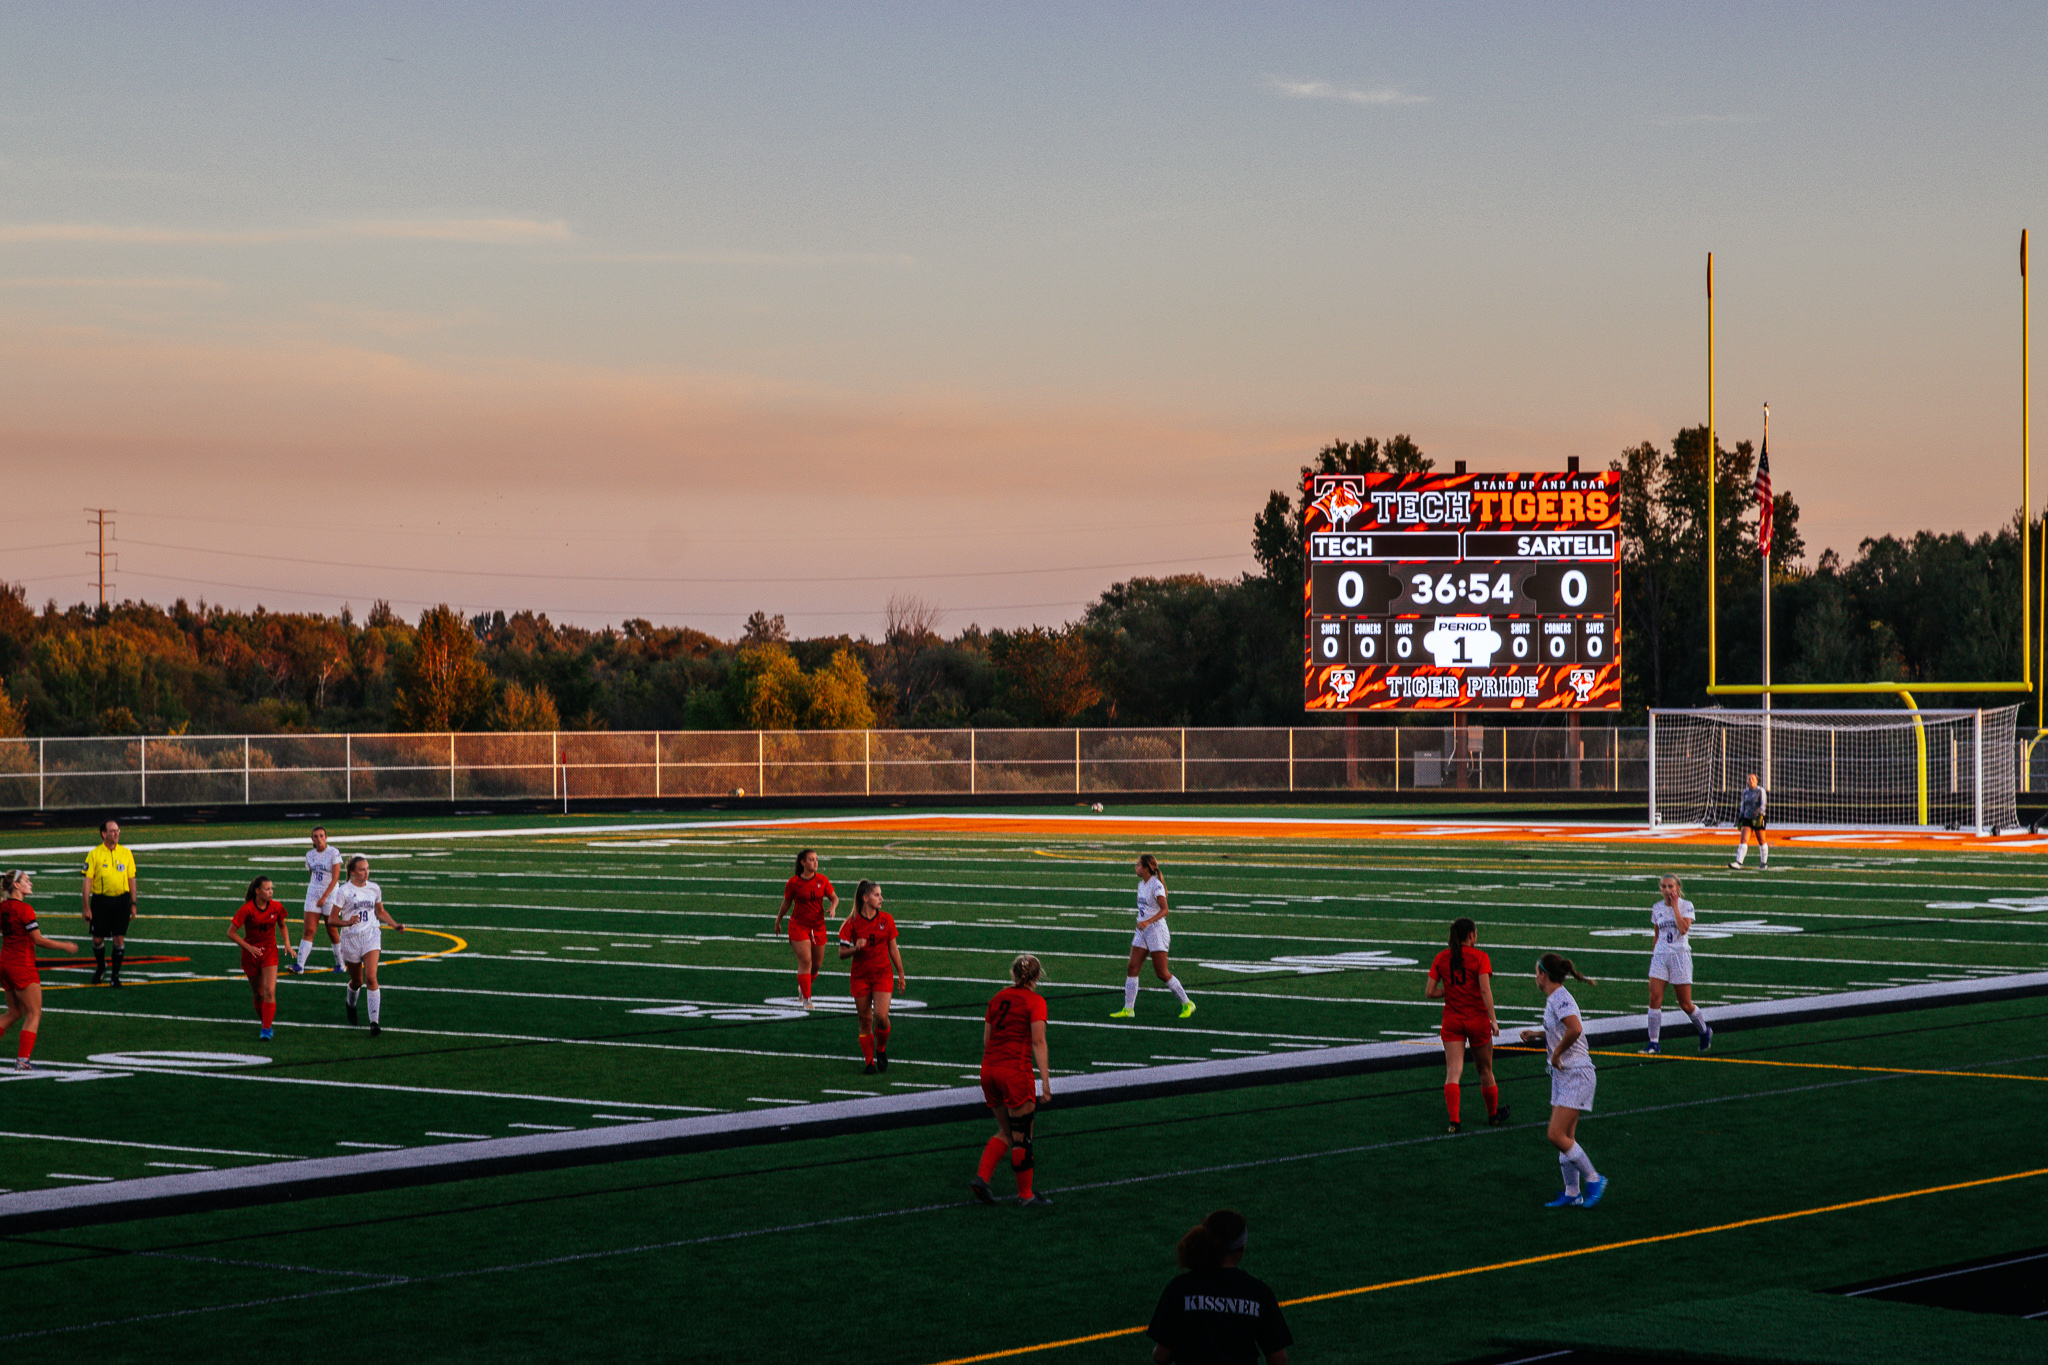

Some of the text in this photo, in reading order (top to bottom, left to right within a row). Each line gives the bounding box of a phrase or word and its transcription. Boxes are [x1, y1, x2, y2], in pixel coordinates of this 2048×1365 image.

[1473, 480, 1605, 490] STAND UP AND ROAR
[1371, 491, 1609, 523] TECH TIGERS
[1314, 537, 1373, 556] TECH
[1517, 536, 1612, 556] SARTELL
[1337, 571, 1365, 607] 0
[1411, 573, 1514, 604] 36:54
[1560, 569, 1588, 607] 0
[1321, 623, 1340, 635] SHOTS
[1354, 623, 1382, 635] CORNERS
[1394, 623, 1413, 635] SAVES
[1438, 622, 1487, 632] PERIOD
[1510, 623, 1530, 634] SHOTS
[1544, 622, 1572, 634] CORNERS
[1585, 622, 1604, 634] SAVES
[1323, 636, 1338, 658] 0
[1360, 636, 1375, 658] 0
[1397, 636, 1412, 658] 0
[1452, 637, 1472, 663] 1
[1512, 636, 1528, 658] 0
[1549, 636, 1565, 658] 0
[1586, 636, 1603, 658] 0
[1386, 676, 1539, 697] TIGER PRIDE
[358, 911, 369, 922] 19
[995, 1000, 1011, 1030] 2
[1184, 1295, 1260, 1317] KISSNER
